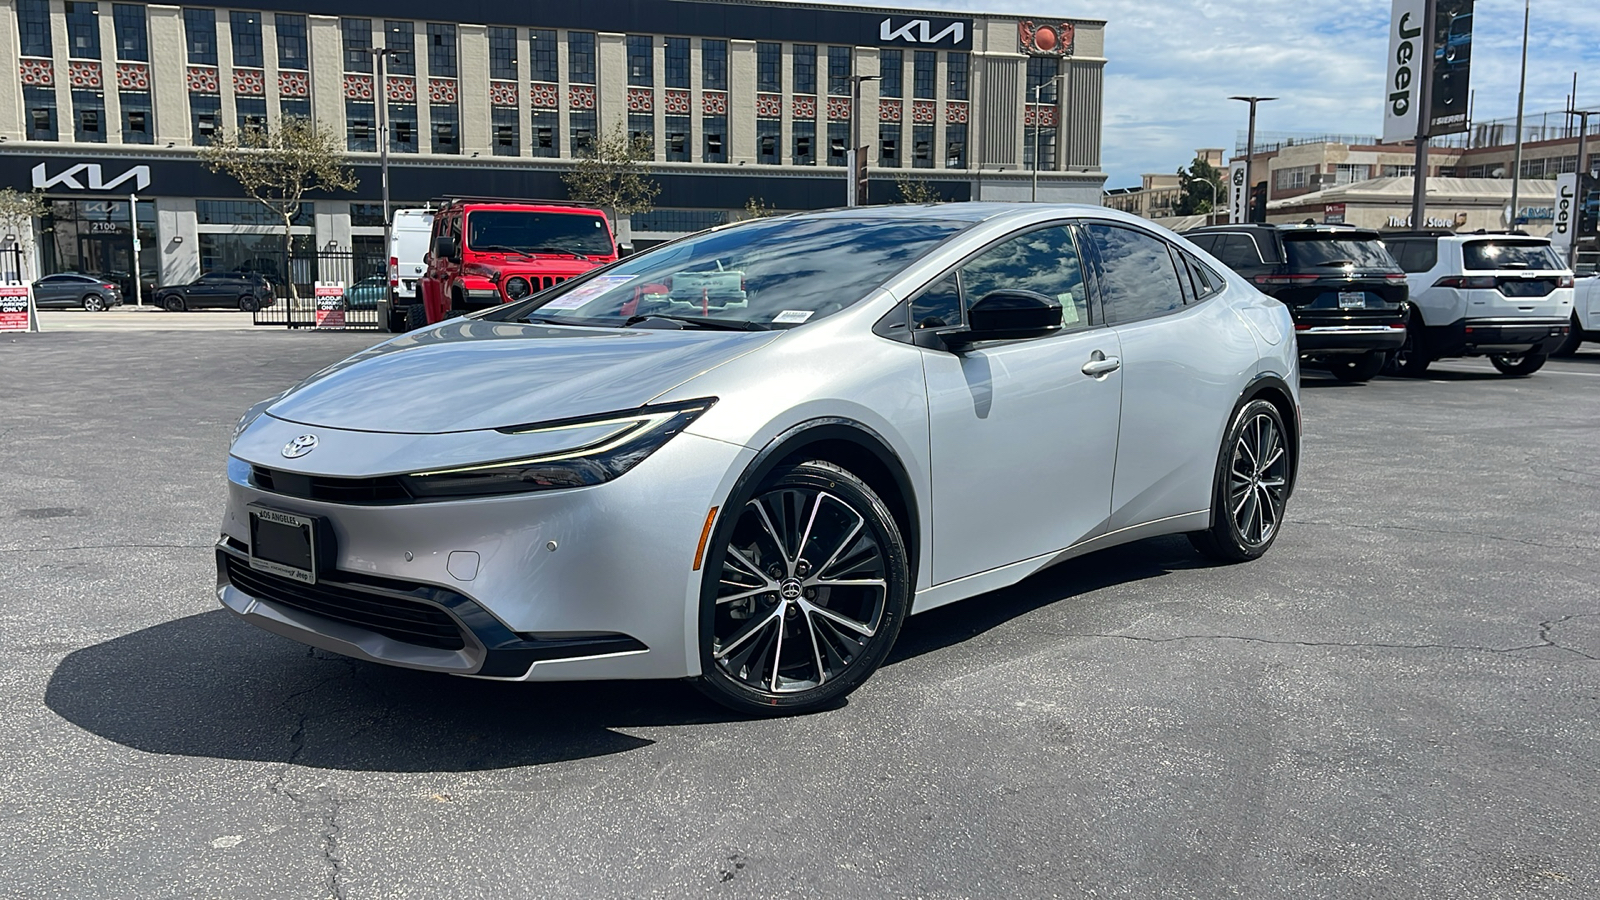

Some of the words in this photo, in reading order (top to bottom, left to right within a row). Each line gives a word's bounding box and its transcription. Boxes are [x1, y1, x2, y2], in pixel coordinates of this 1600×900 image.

[880, 17, 964, 44] KIA
[1389, 11, 1421, 117] Jeep
[32, 162, 150, 191] KIA
[1389, 215, 1406, 228] The
[1427, 216, 1453, 228] Store
[1555, 185, 1574, 234] Jeep
[92, 222, 116, 231] 2100
[260, 510, 271, 519] LOS
[271, 512, 297, 525] ANGELES
